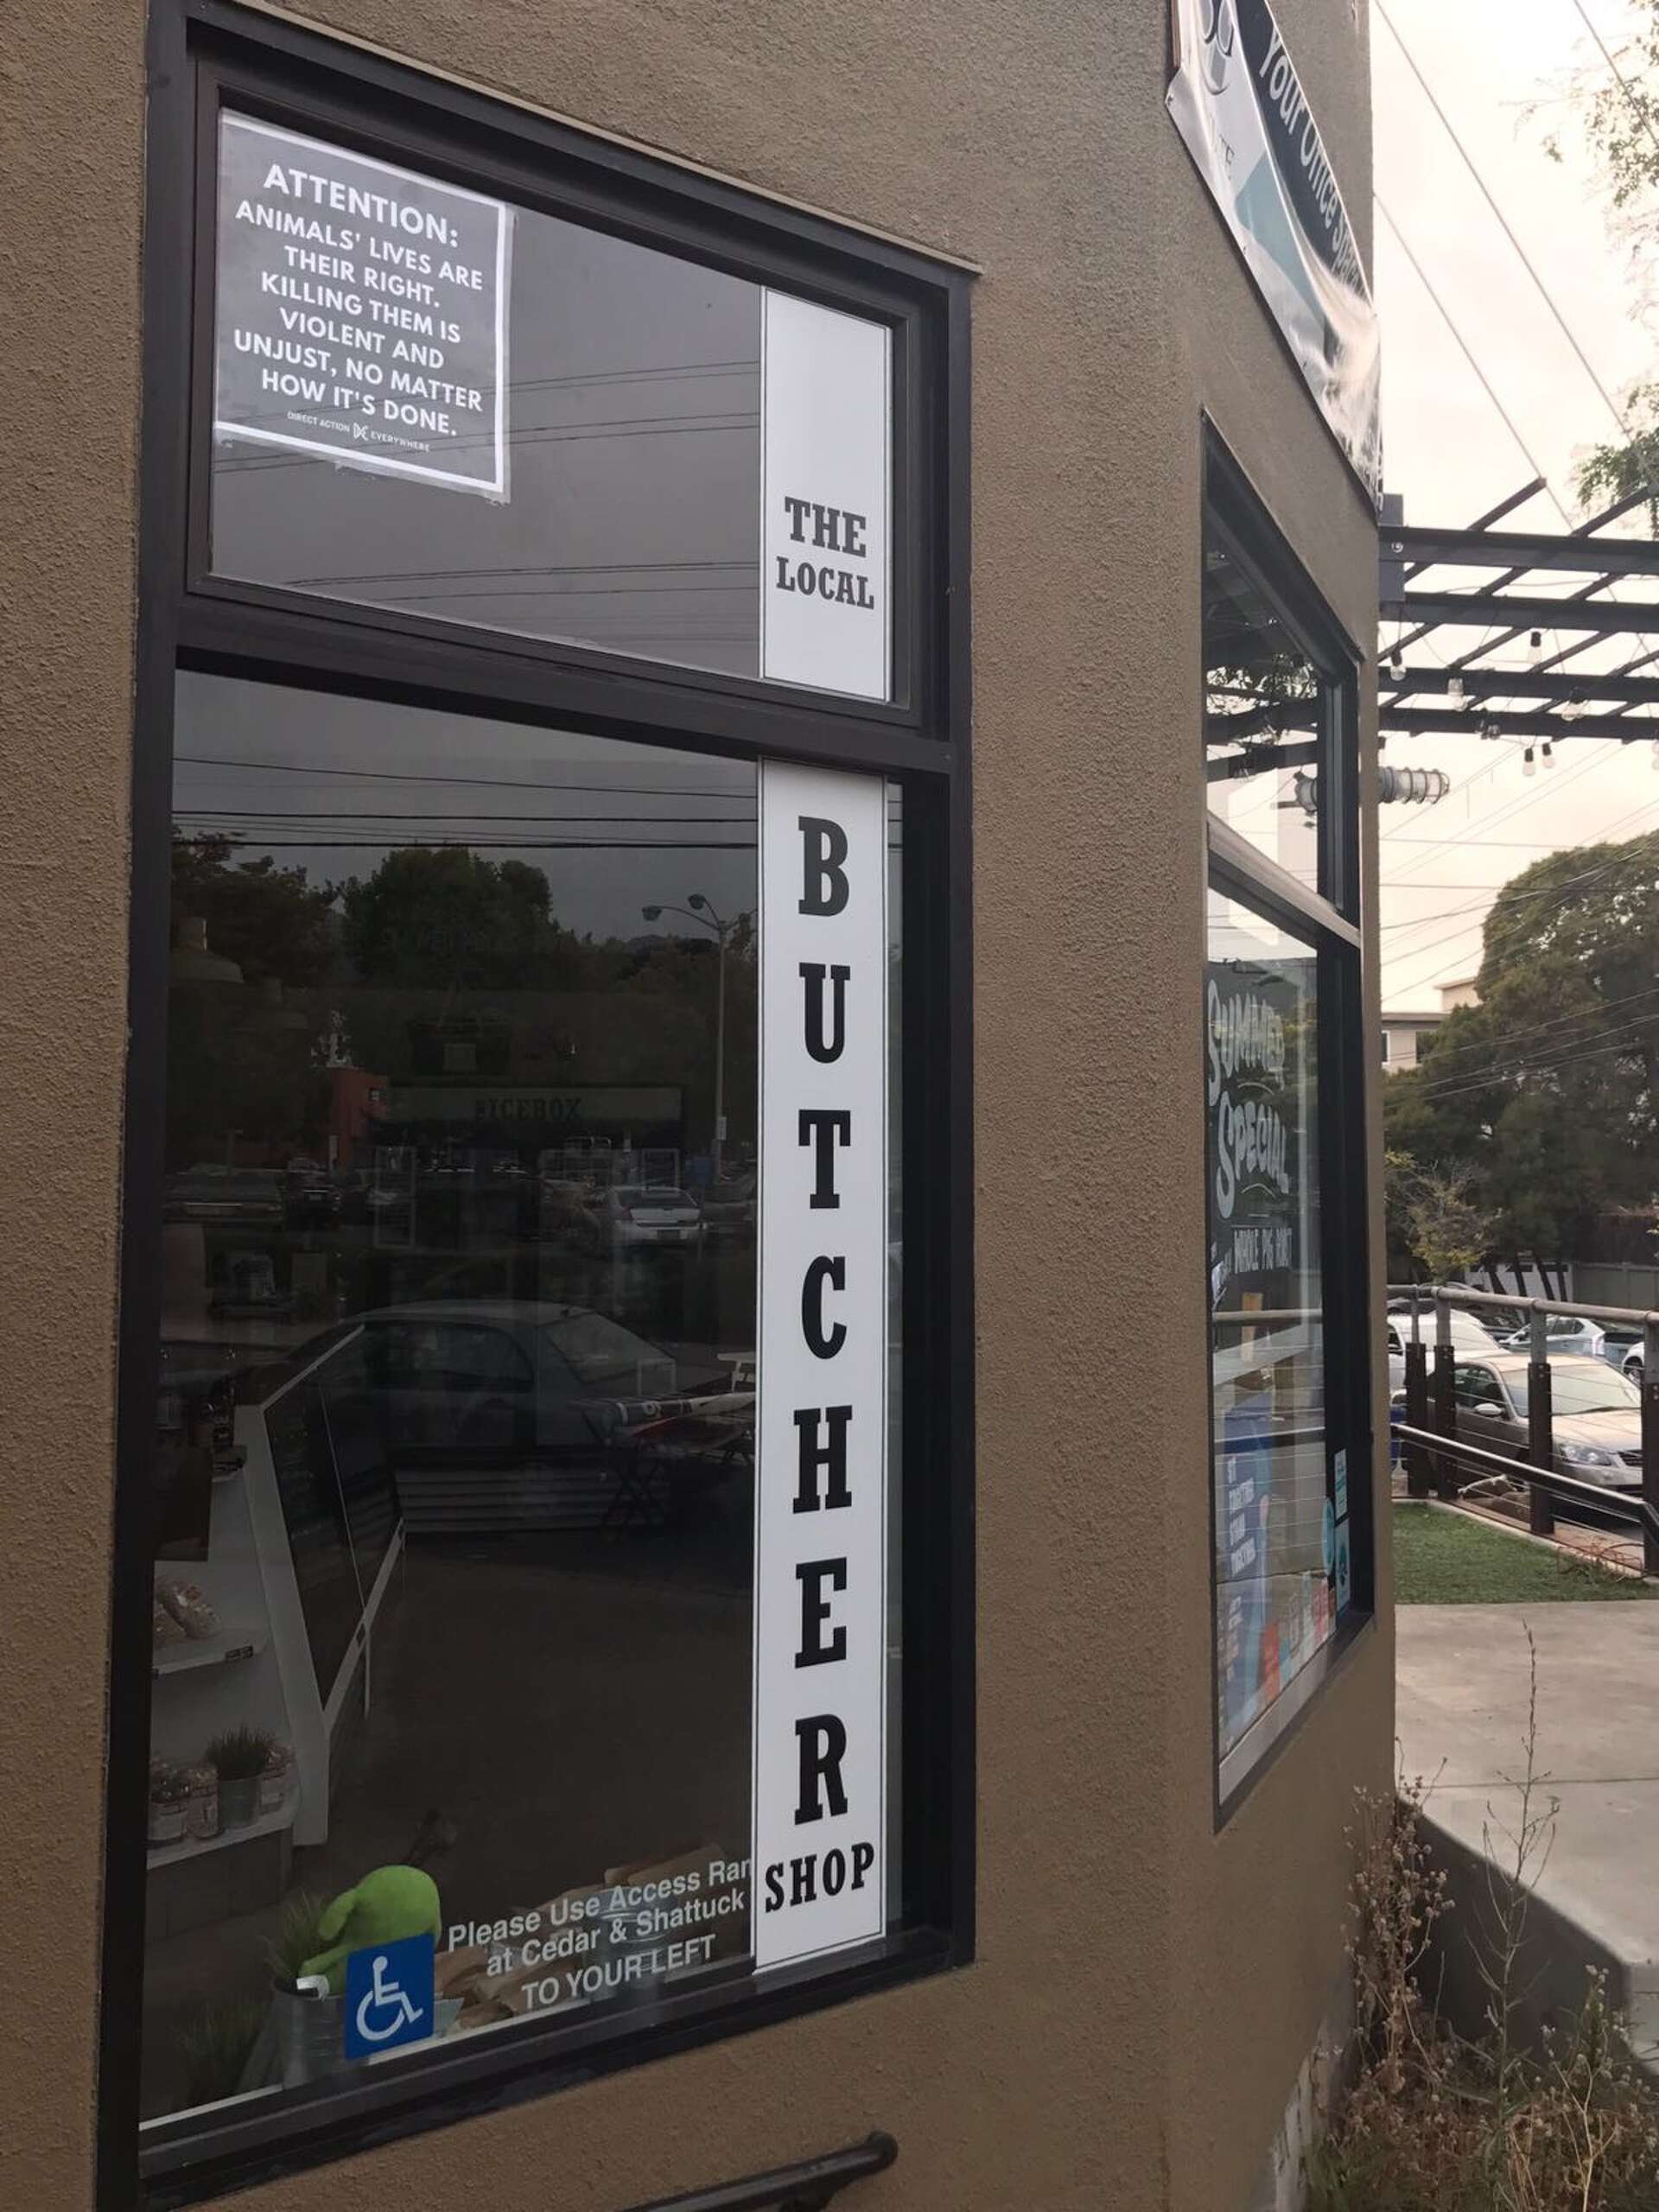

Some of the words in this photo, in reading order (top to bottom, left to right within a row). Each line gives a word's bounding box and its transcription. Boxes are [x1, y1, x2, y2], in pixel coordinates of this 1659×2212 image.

[264, 164, 459, 247] ATTENTION:
[235, 200, 361, 251] ANIMALS'
[369, 237, 431, 275] LIVES
[439, 262, 483, 290] ARE
[284, 245, 356, 283] THEIR
[364, 266, 441, 308] RIGHT.
[261, 271, 362, 315] KILLING
[369, 300, 433, 335] THEM
[440, 321, 461, 343] IS
[279, 307, 385, 354] VIOLENT
[391, 339, 444, 370] AND
[234, 328, 338, 378] UNJUST,
[346, 357, 383, 385] NO
[391, 369, 482, 412] MATTER
[262, 368, 325, 403] HOW
[334, 386, 376, 415] IT'S
[384, 398, 458, 435] DONE.
[287, 410, 317, 425] DIRECT
[319, 419, 350, 433] ACTION
[371, 432, 430, 452] EVERYWHERE
[785, 495, 867, 558] THE
[776, 555, 874, 610] LOCAL
[1217, 1091, 1290, 1218] SPECIAL
[792, 816, 852, 1826] BUTCHER
[448, 1910, 541, 1953] Please
[550, 1896, 601, 1926] Use
[609, 1872, 701, 1911] Access
[765, 1841, 874, 1913] SHOP
[486, 1947, 513, 1976] at
[522, 1929, 601, 1966] Cedar
[609, 1917, 627, 1943] &
[636, 1888, 745, 1936] Shattuck
[521, 1977, 560, 2009] TO
[565, 1954, 641, 1997] YOUR
[652, 1934, 715, 1974] LEFT
